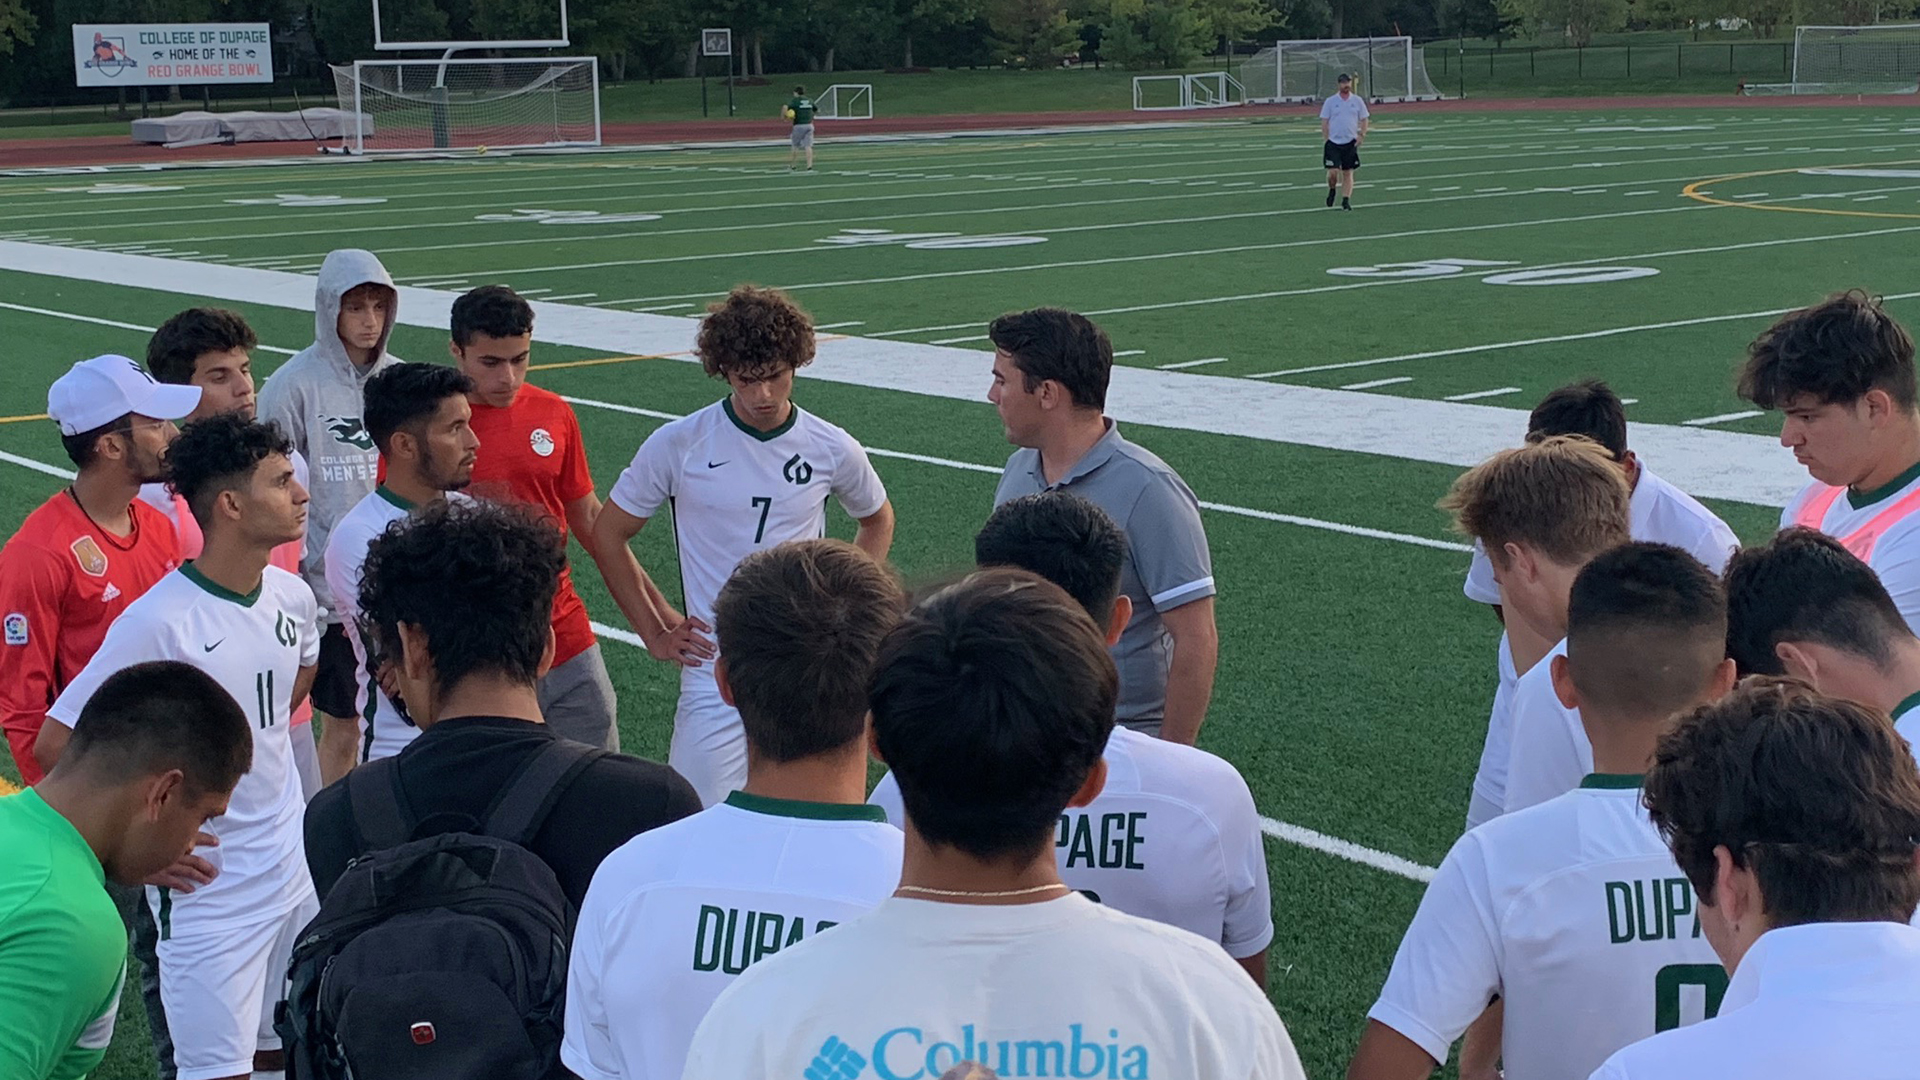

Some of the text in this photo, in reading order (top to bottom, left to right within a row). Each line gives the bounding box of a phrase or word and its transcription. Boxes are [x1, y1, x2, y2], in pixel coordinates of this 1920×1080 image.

[139, 30, 267, 45] COLLEGE OF DUPAGE
[169, 48, 239, 60] HOME OF THE
[148, 64, 171, 77] RED
[176, 63, 225, 77] GRANGE
[229, 63, 263, 76] BOWL
[320, 455, 364, 464] COLLEGE
[322, 465, 366, 482] MEN'S
[752, 496, 772, 544] 7
[257, 669, 274, 729] 11
[693, 904, 840, 975] DUP
[872, 1023, 1149, 1080] Columbia
